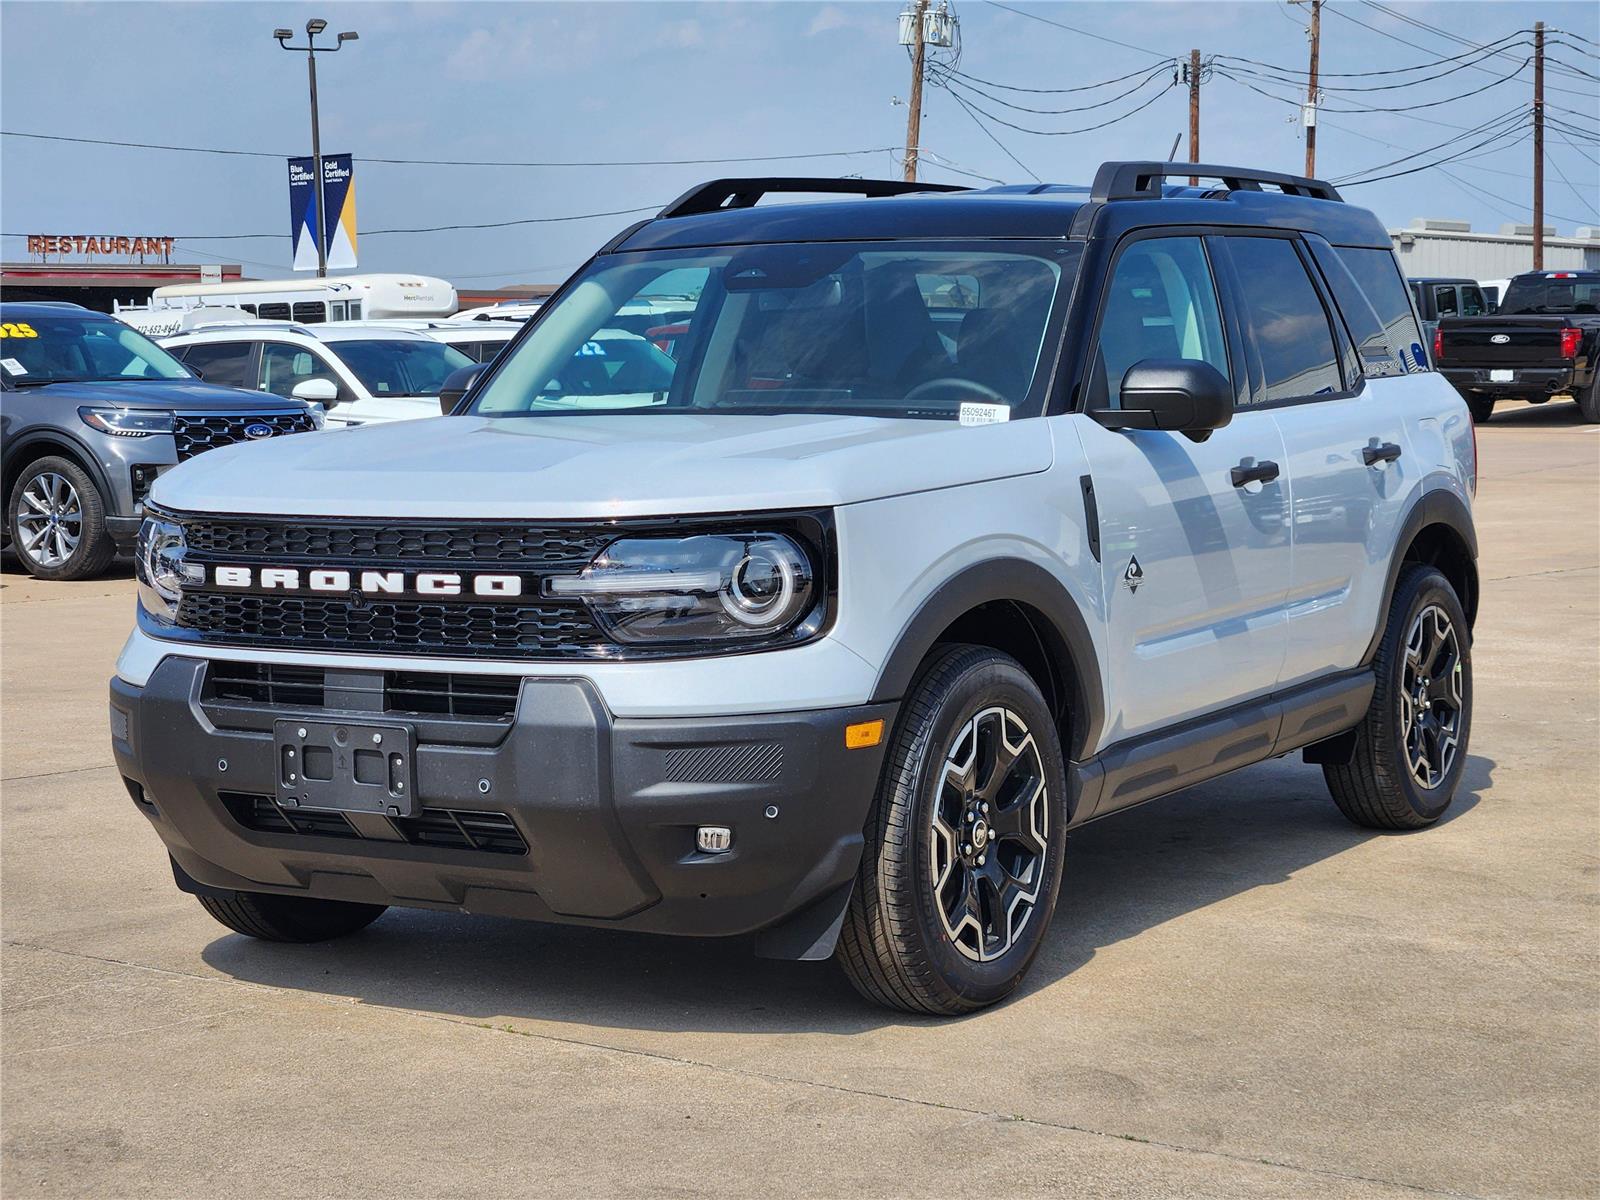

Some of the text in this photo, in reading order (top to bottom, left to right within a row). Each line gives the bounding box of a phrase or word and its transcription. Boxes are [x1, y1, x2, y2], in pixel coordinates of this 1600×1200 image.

[325, 161, 337, 169] Gold
[290, 172, 314, 181] Certified
[325, 168, 349, 177] Certified
[28, 236, 174, 254] RESTAURANT
[961, 407, 996, 417] 6509246T
[215, 566, 521, 596] BRONCO
